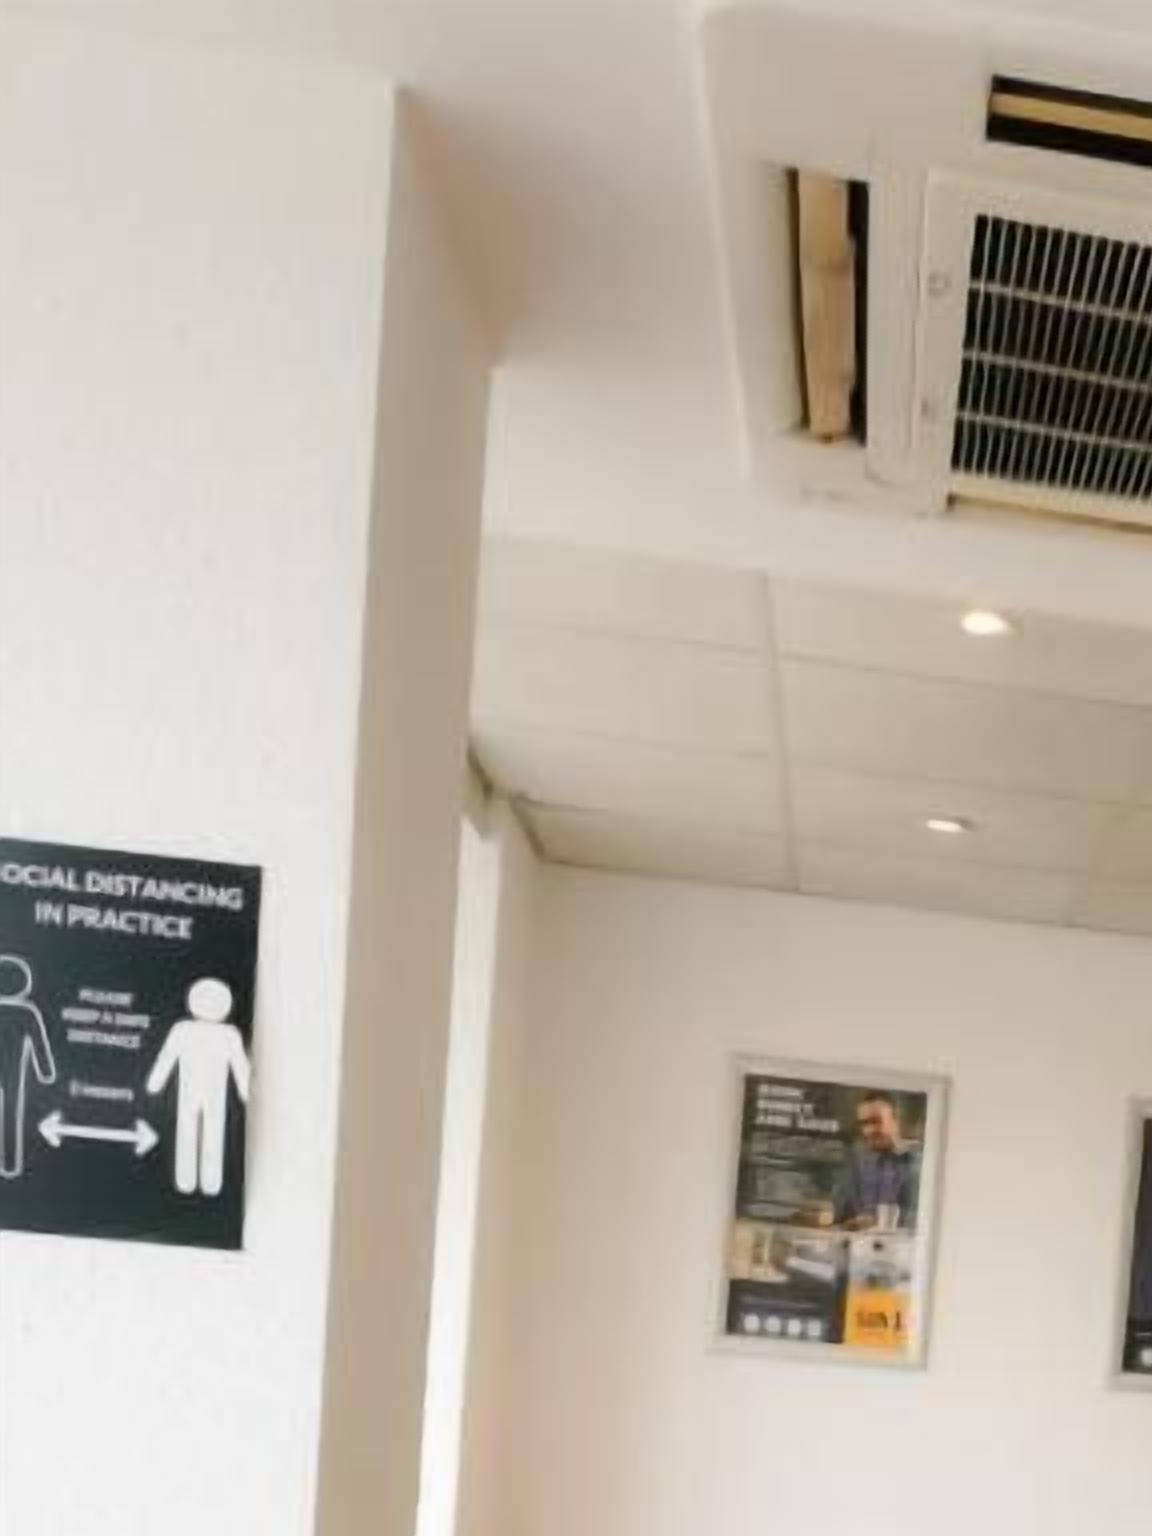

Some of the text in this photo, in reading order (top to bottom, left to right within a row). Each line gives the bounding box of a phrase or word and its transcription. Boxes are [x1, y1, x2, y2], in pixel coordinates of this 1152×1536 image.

[0, 863, 244, 911] OCIAL DISTANCING
[34, 900, 193, 940] IN PRACTICE
